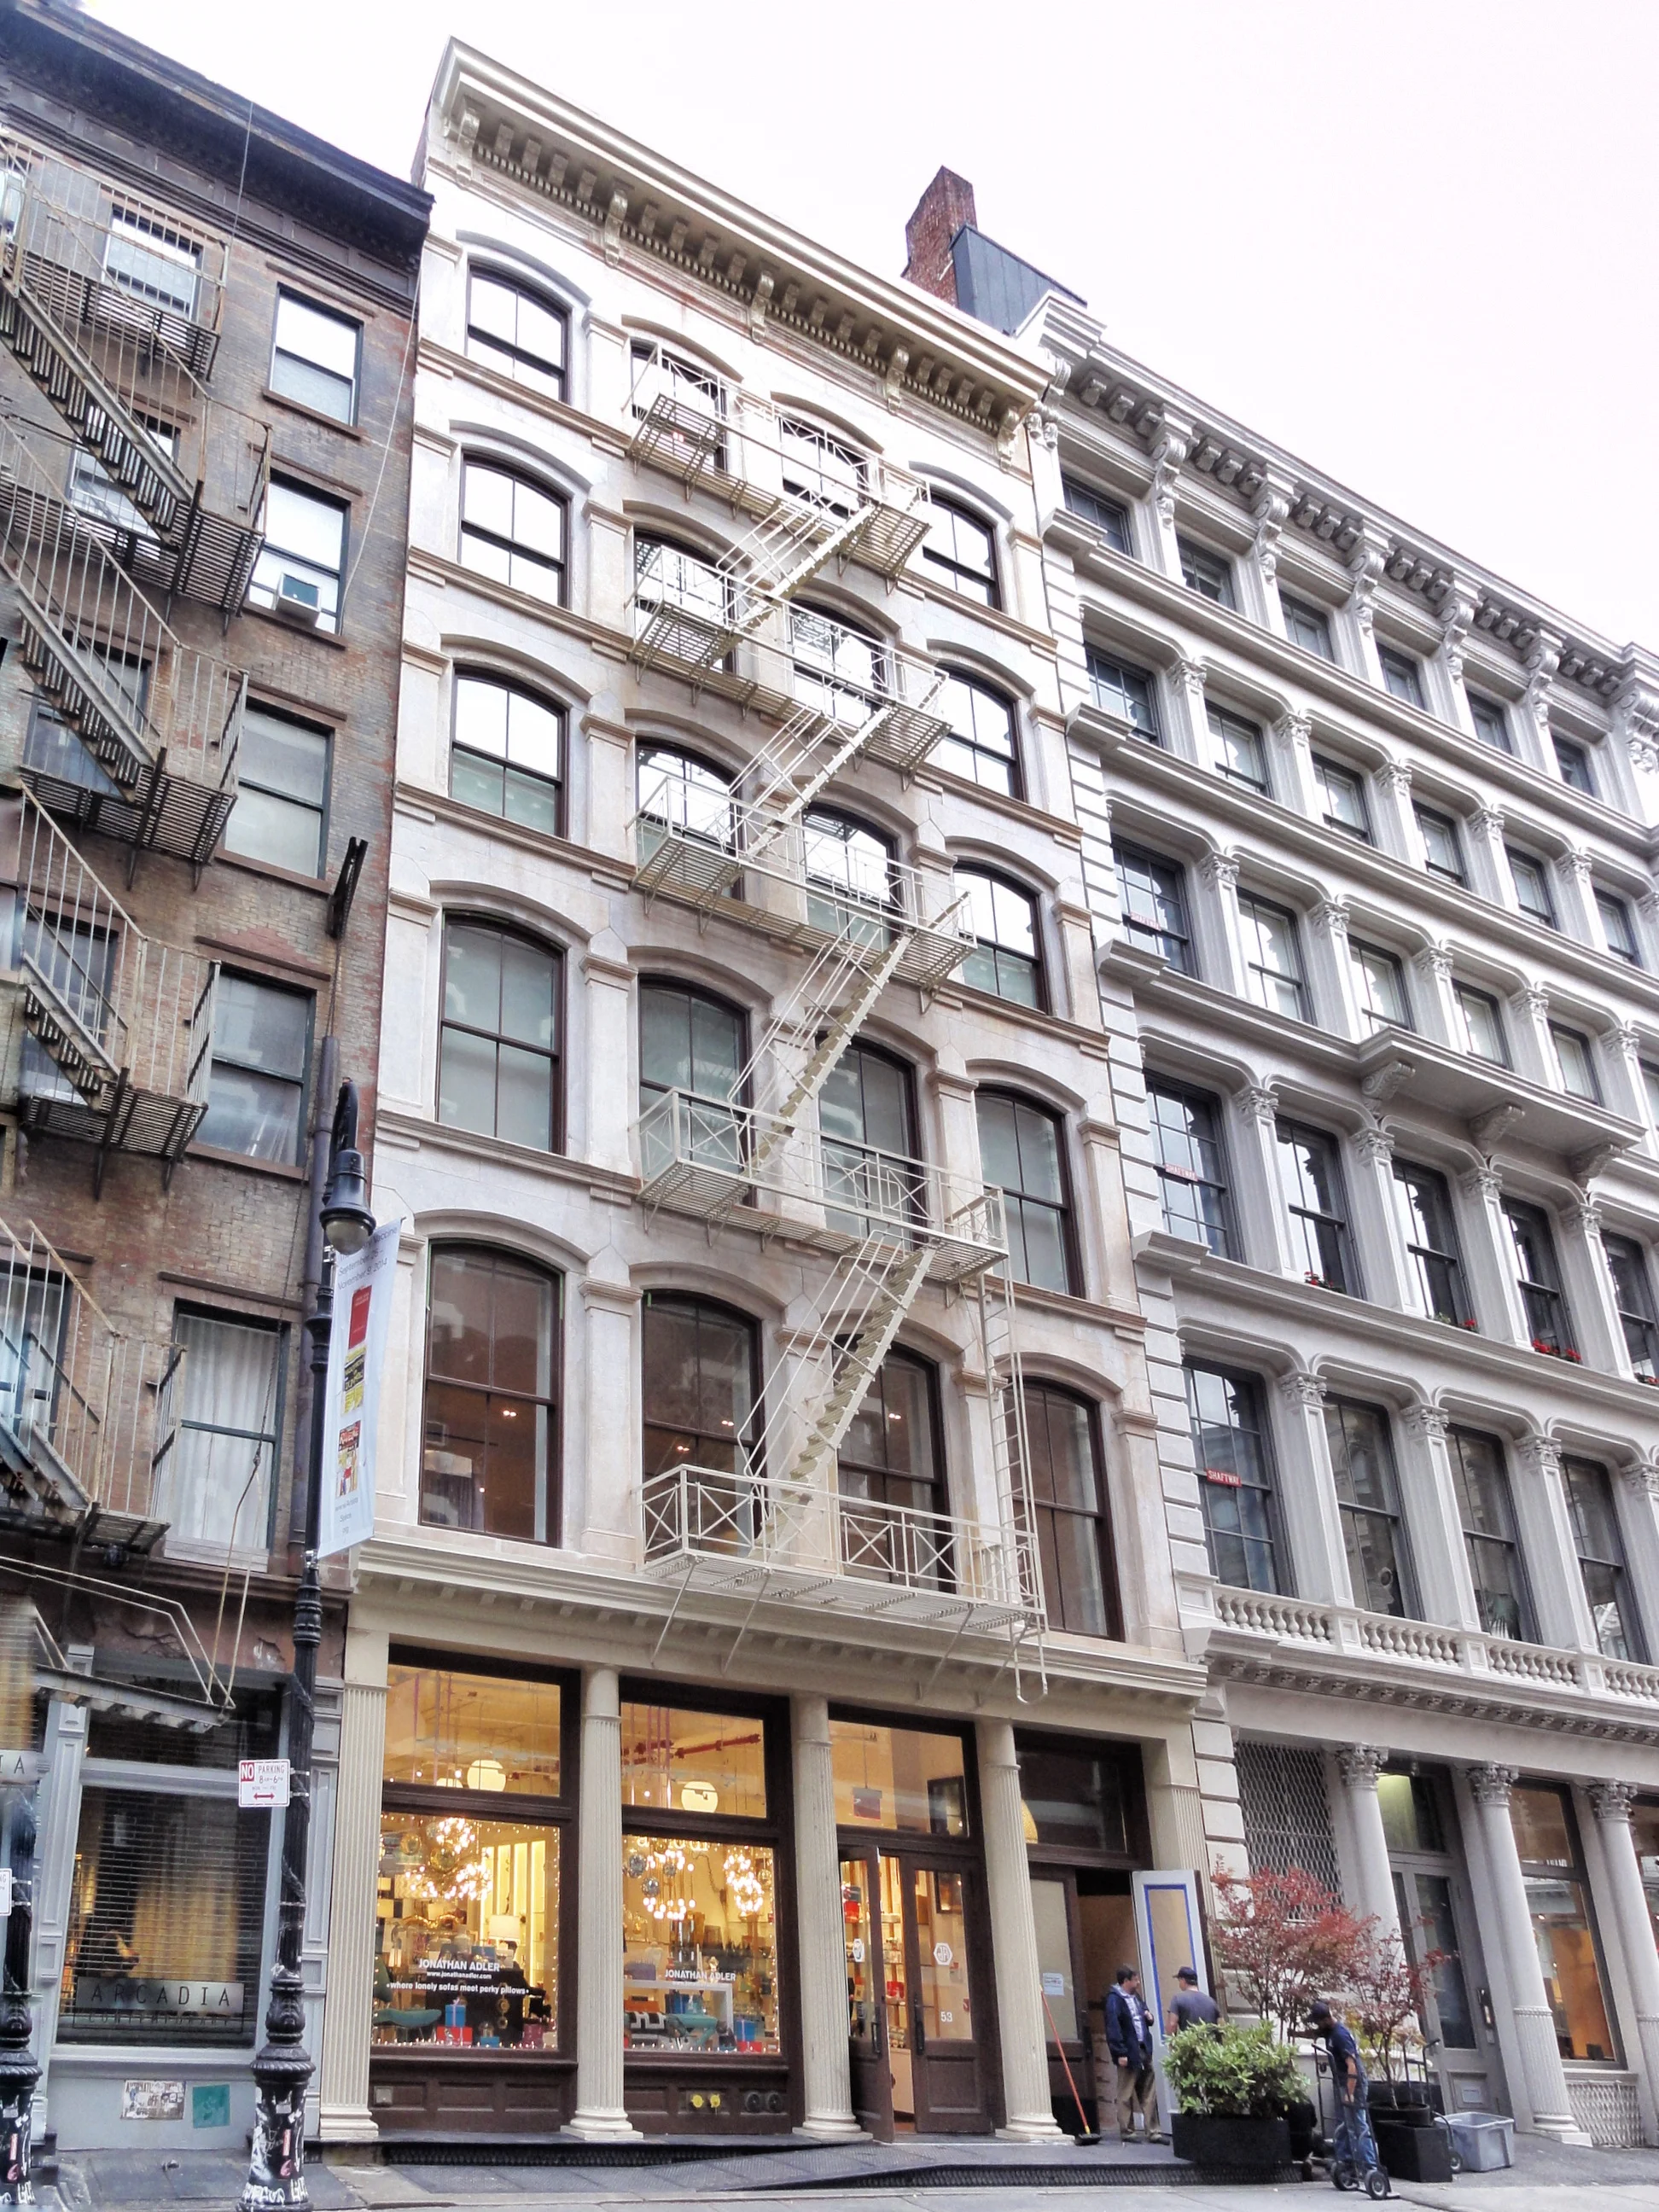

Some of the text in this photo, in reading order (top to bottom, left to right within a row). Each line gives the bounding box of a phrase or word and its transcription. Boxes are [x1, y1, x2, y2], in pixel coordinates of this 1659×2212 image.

[1208, 1470, 1240, 1486] SHAFTWAY
[242, 1764, 285, 1779] NO PARKING
[419, 1959, 500, 1972] JONATHAN ADLER
[427, 1970, 492, 1980] www.jonathanadler.com
[665, 1969, 736, 1981] JONATHAN ADLER
[90, 1983, 230, 2006] ARCADIA
[390, 1982, 526, 1995] where lonely sofas meet perky pillows
[940, 2011, 953, 2023] 53
